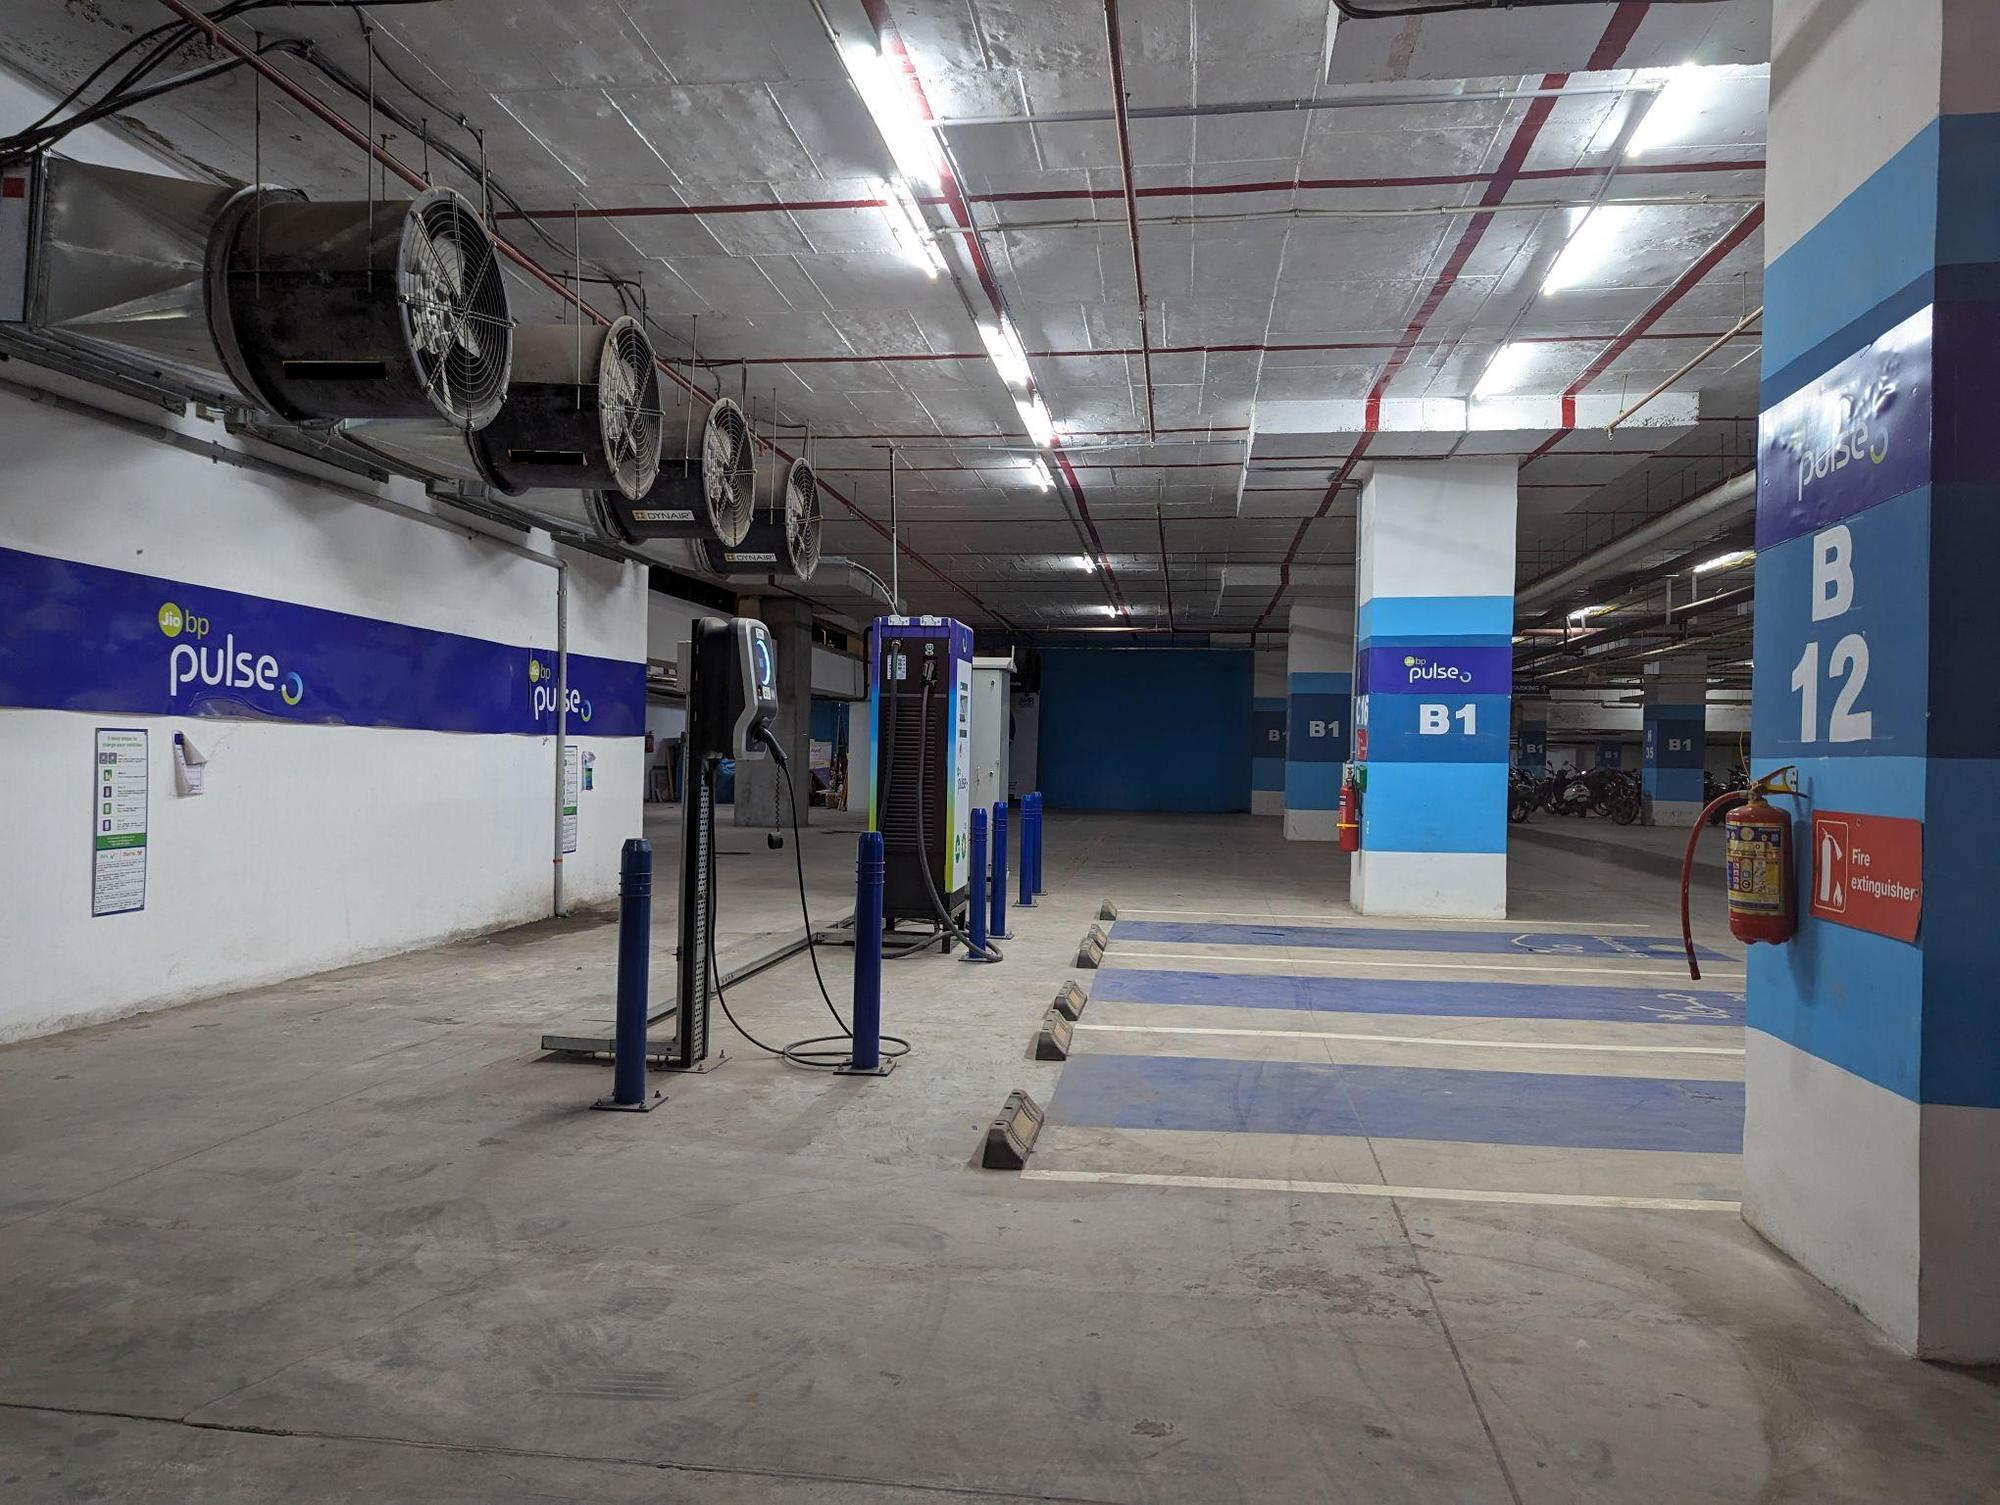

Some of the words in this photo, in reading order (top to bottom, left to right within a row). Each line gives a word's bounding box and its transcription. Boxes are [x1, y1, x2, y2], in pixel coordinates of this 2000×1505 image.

[1798, 420, 1869, 502] pulse
[648, 512, 689, 520] DYNAIR
[1812, 525, 1854, 622] B
[160, 611, 181, 627] Jio
[186, 610, 210, 640] bp
[170, 633, 279, 697] pulse
[541, 664, 551, 683] bp
[1409, 662, 1459, 684] pulse
[1415, 657, 1427, 666] bp
[1791, 633, 1872, 743] 12
[534, 686, 581, 721] puse
[1309, 720, 1340, 738] B1
[1420, 704, 1476, 735] B1
[1526, 744, 1544, 753] B1
[1669, 738, 1692, 751] B1
[1852, 848, 1871, 866] Fire
[1851, 875, 1915, 901] extinguisher
